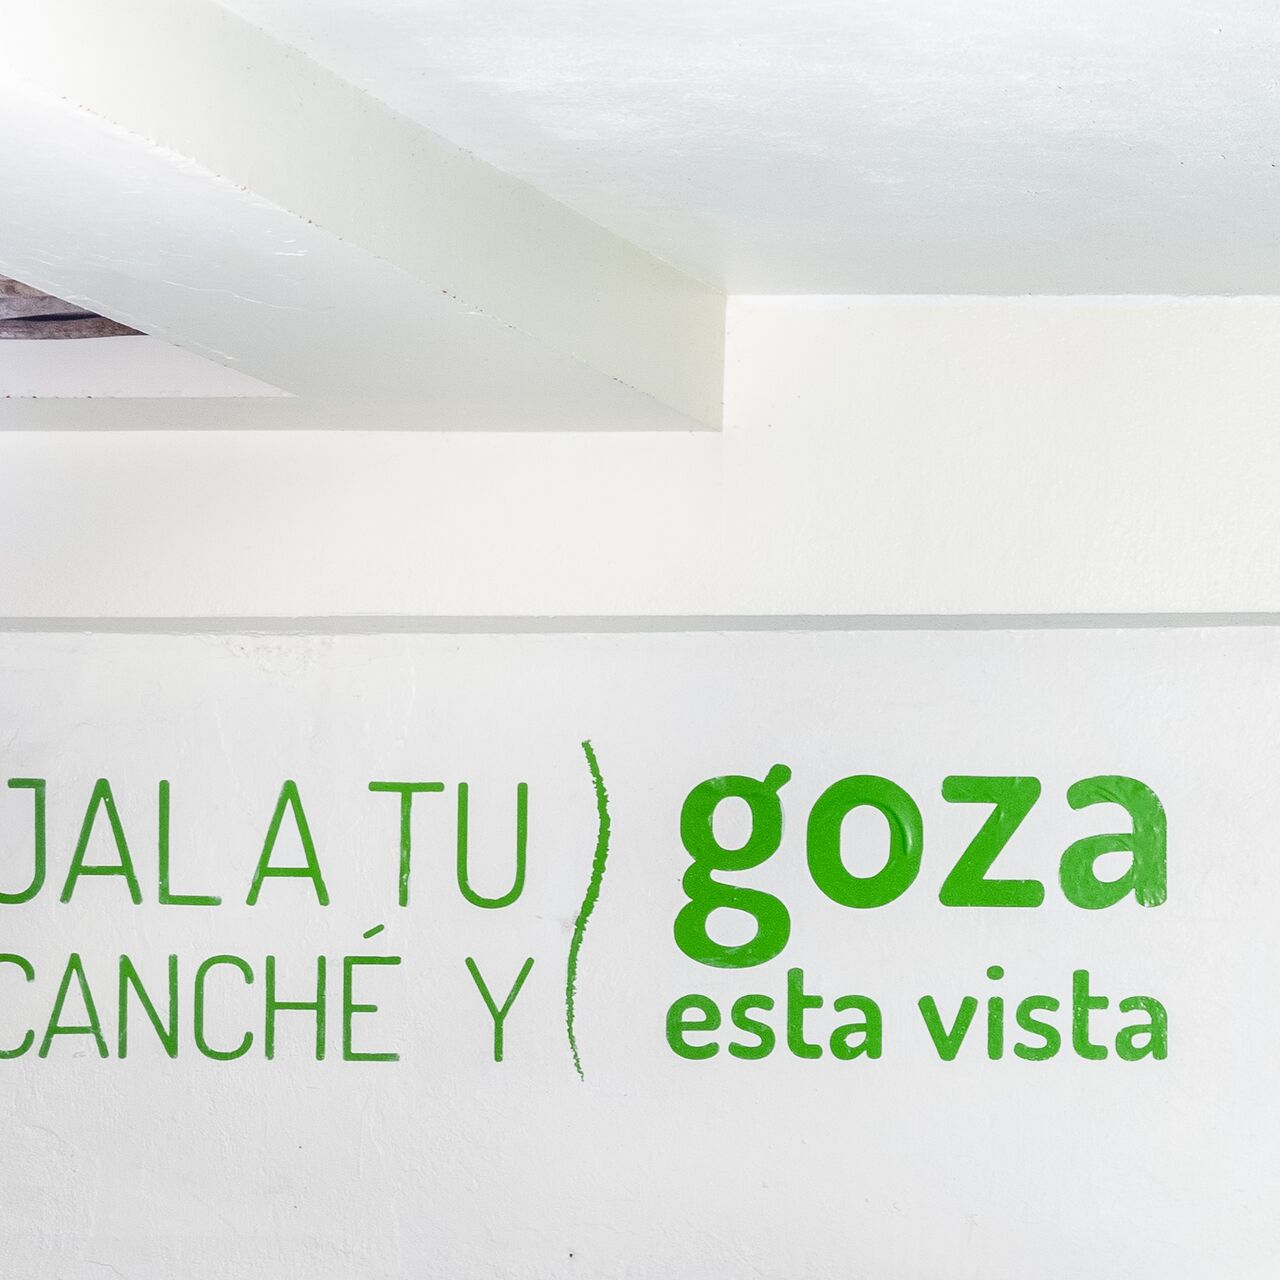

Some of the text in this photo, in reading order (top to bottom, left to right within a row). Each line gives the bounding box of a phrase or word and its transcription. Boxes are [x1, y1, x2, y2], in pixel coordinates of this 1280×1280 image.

[0, 778, 529, 909] JALA TU
[673, 763, 1168, 970] goza
[465, 957, 535, 1062] Y
[665, 965, 1168, 1062] esta vista
